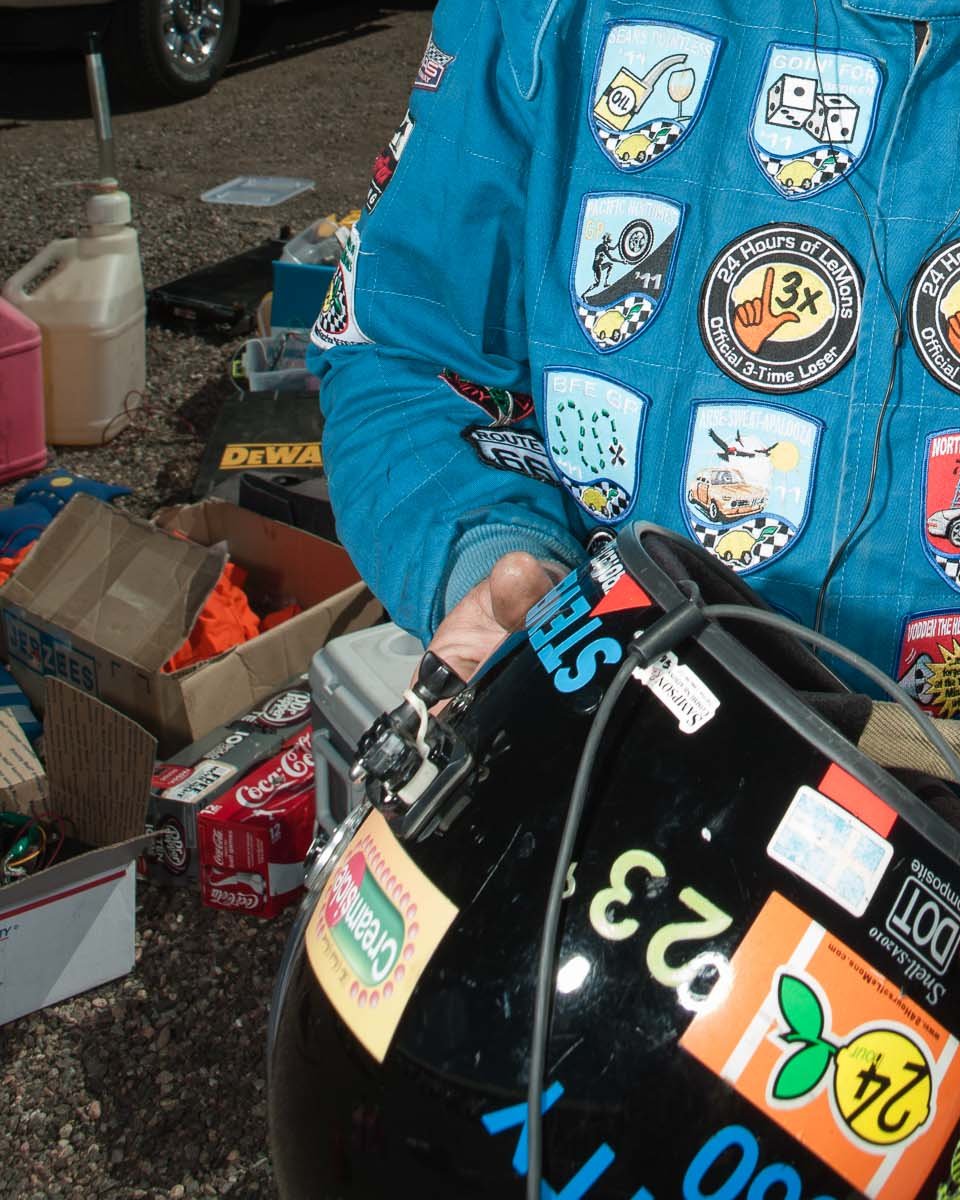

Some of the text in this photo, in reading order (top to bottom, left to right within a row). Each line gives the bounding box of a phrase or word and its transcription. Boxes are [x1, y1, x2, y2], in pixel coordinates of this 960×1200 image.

[840, 64, 876, 81] FOR
[612, 90, 630, 111] OIL
[634, 272, 662, 290] '11
[717, 236, 854, 319] 24 Hours of LeMons
[922, 269, 945, 297] 24
[711, 316, 838, 383] Official 3-Time Loser
[921, 327, 960, 380] Official
[553, 376, 639, 414] BFE GP
[476, 432, 543, 453] ROUTE
[490, 447, 555, 481] 66
[936, 618, 953, 636] THE
[892, 888, 960, 966] DOT
[845, 1053, 929, 1133] 24
